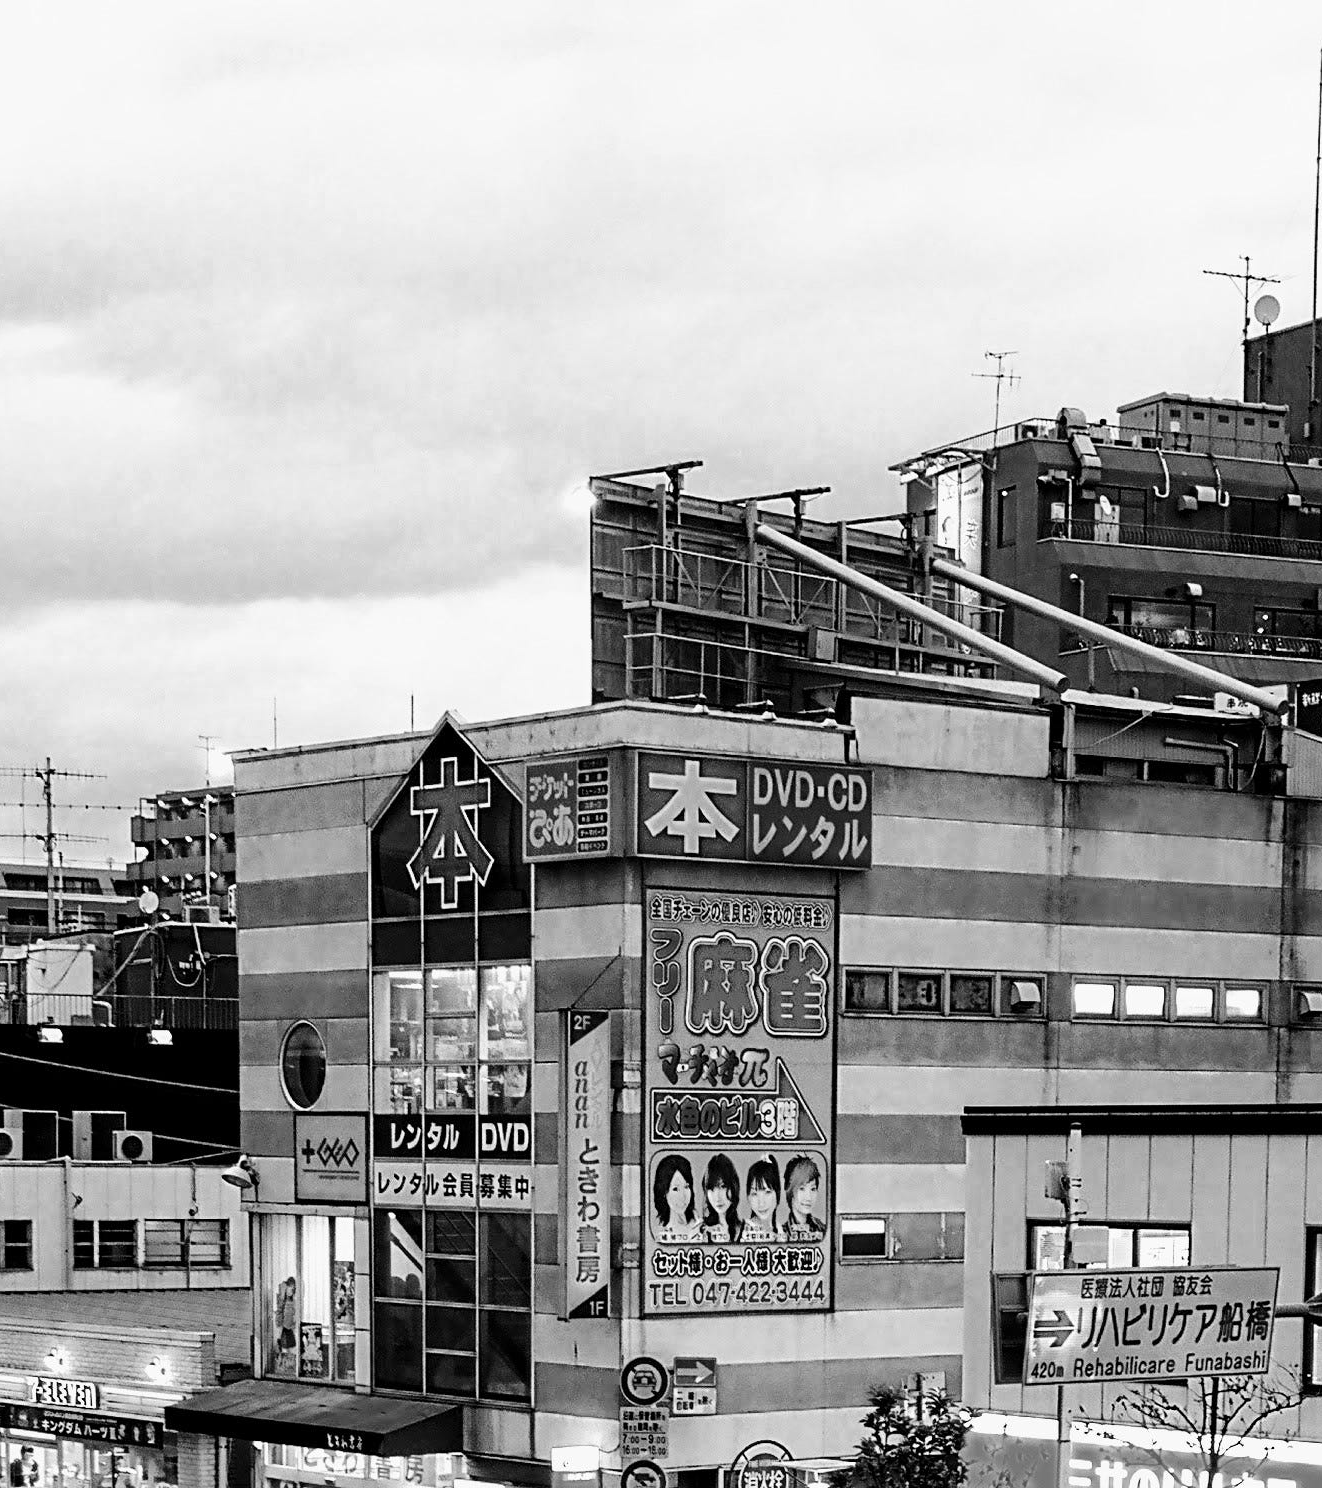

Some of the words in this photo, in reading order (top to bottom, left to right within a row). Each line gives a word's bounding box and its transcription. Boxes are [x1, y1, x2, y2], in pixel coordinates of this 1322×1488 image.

[529, 804, 574, 848] ぴあ
[644, 759, 740, 854] 本
[405, 756, 494, 909] 本
[753, 813, 868, 861] レンタル
[651, 927, 683, 1034] フリー
[685, 930, 829, 1037] 麻雀
[573, 1014, 592, 1032] 2F
[390, 1122, 460, 1150] レンタル
[481, 1122, 528, 1151] DVD
[655, 1095, 799, 1139] 水色のビル3階
[576, 1137, 601, 1283] ときわ書房
[589, 1300, 606, 1316] 1F
[649, 1283, 687, 1306] TEL
[1080, 1277, 1164, 1298] 医療法人社団
[1173, 1274, 1213, 1297] 協友会
[1078, 1299, 1271, 1350] リハビリケア船橋
[1073, 1357, 1177, 1378] Rehabilicare
[1185, 1350, 1268, 1373] Funabashi
